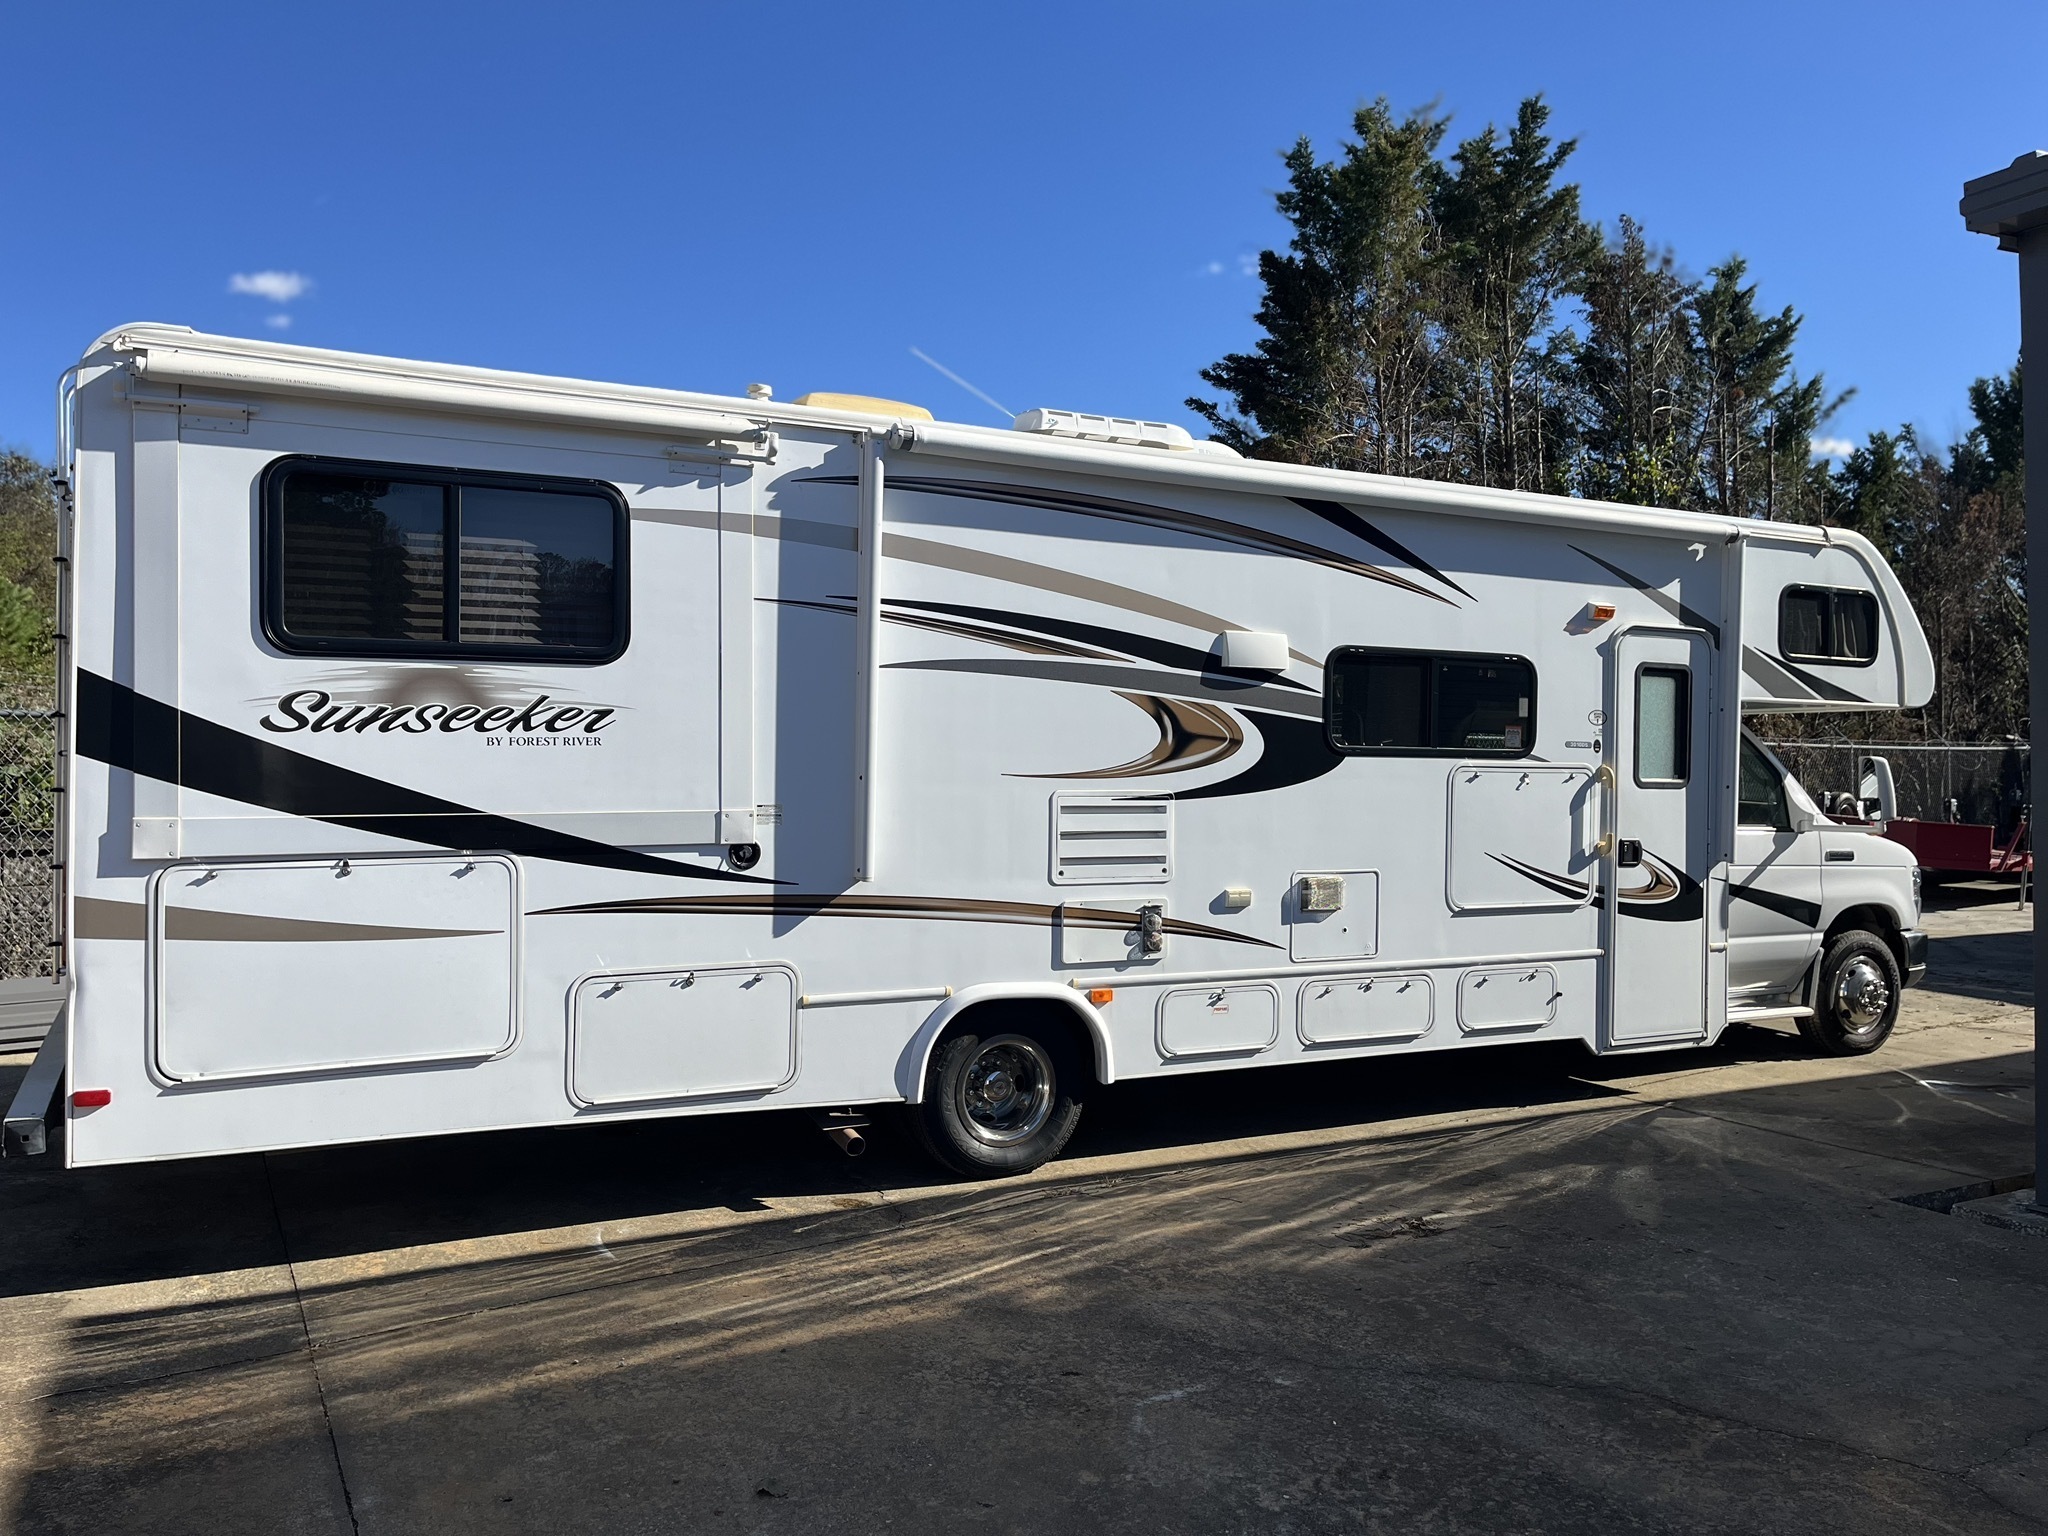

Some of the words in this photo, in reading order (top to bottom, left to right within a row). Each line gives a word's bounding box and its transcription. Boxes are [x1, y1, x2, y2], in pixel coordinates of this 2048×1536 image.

[259, 690, 616, 734] Sunseeker
[486, 736, 503, 747] BY
[508, 736, 560, 747] FOREST
[562, 736, 602, 747] RIVER
